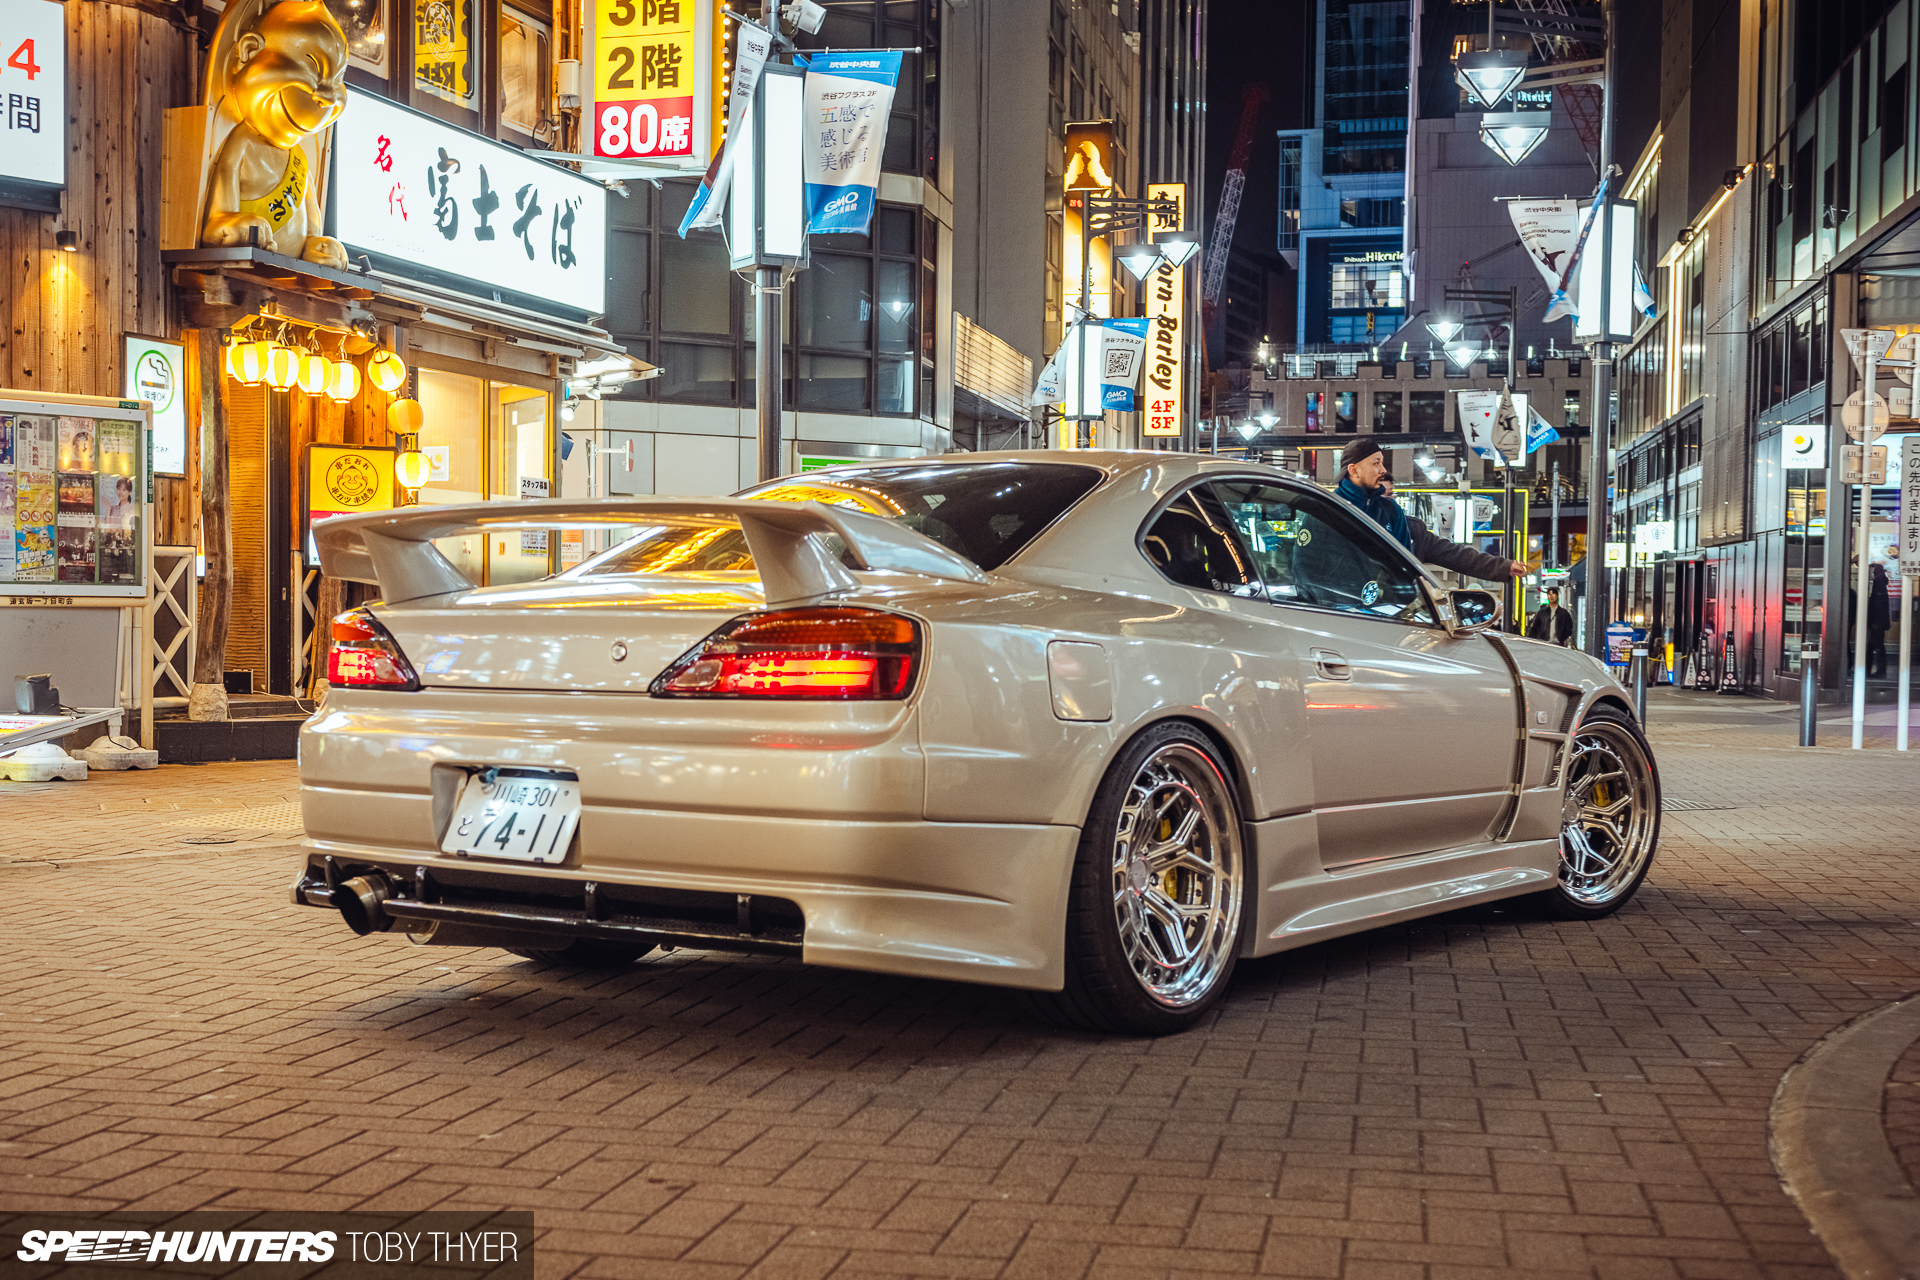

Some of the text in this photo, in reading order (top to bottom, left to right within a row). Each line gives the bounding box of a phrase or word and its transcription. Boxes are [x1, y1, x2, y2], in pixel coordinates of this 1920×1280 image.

[0, 38, 41, 81] 4
[608, 43, 683, 90] 2階
[829, 61, 881, 69] 渋谷中央街
[821, 91, 866, 100] 渋谷フクラス
[0, 92, 41, 134] 間
[820, 104, 876, 124] 五感で
[600, 103, 691, 156] 80席
[820, 125, 869, 148] 感じる
[427, 147, 582, 270] 富士そば
[824, 192, 859, 213] GMO
[1149, 259, 1178, 392] orn-Barley
[1106, 390, 1127, 399] GMO
[1151, 400, 1175, 412] 4F
[1151, 417, 1175, 429] 3F
[334, 457, 369, 470] 串だおれ
[522, 479, 548, 490] スタッフ募集
[1907, 444, 1920, 553] この先行き止まり
[528, 786, 560, 807] 301
[457, 809, 567, 854] と 74-11
